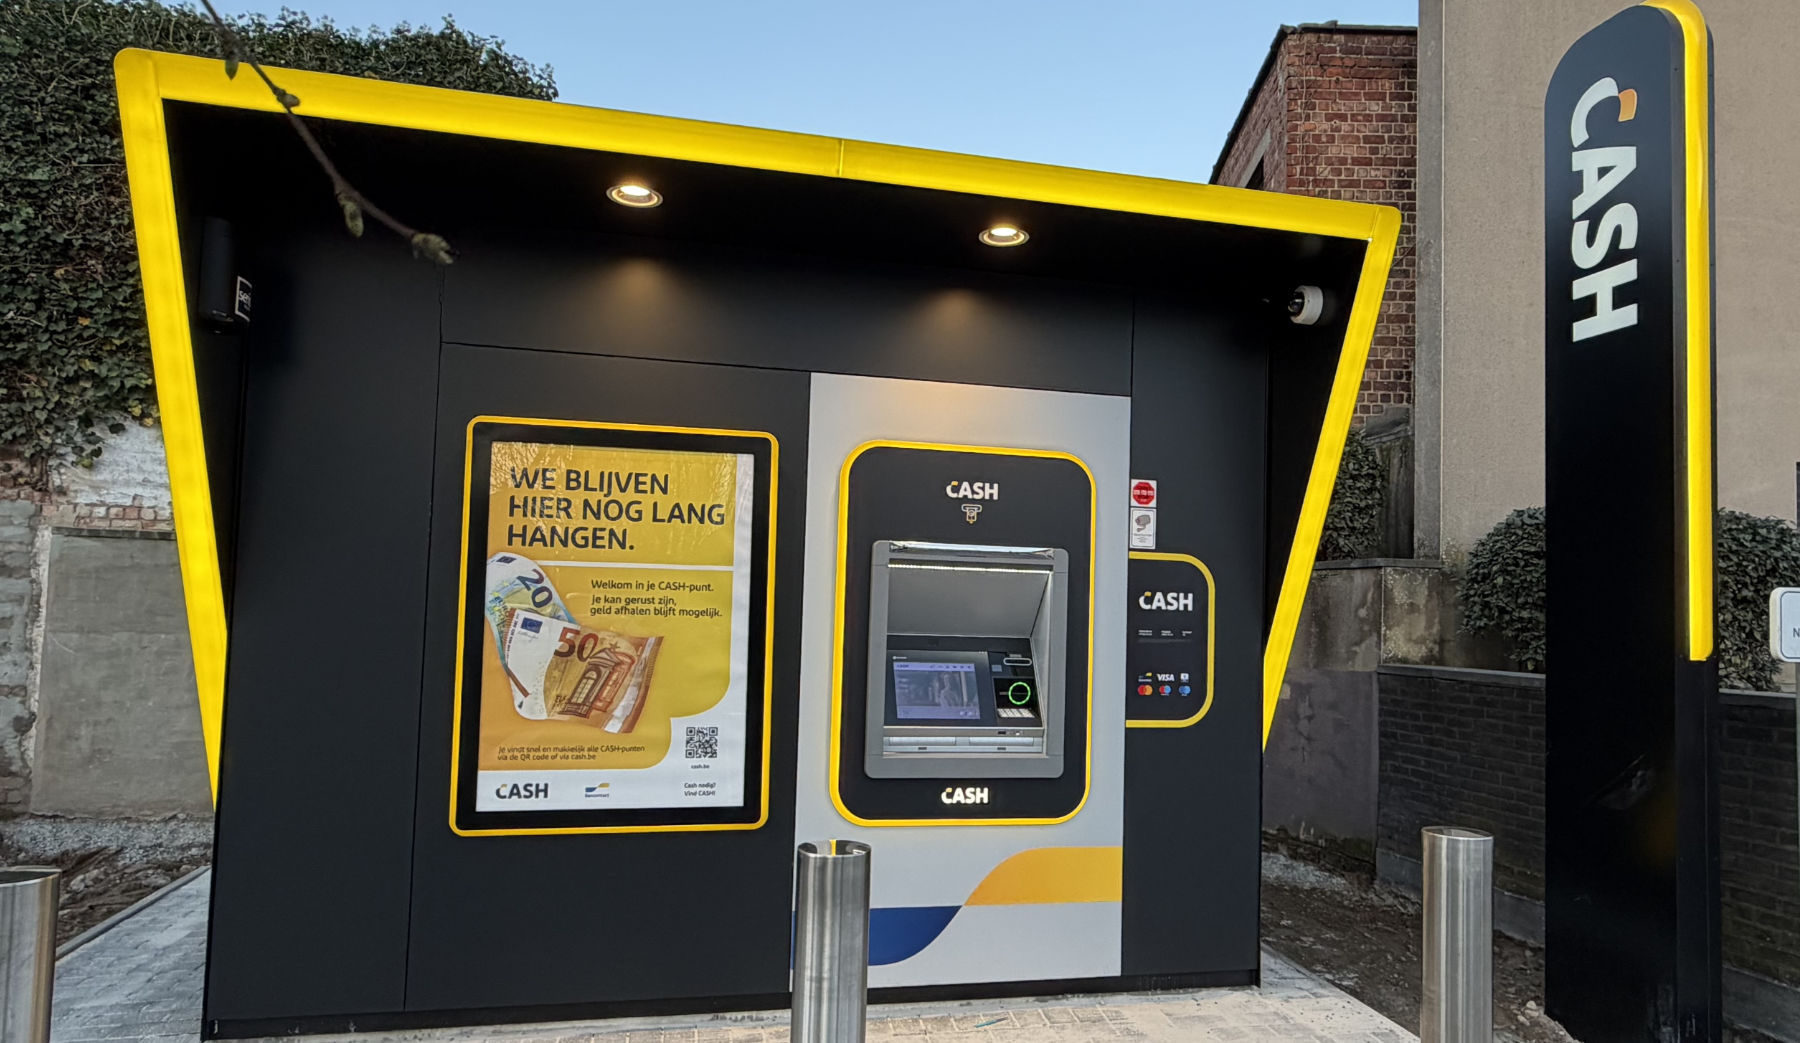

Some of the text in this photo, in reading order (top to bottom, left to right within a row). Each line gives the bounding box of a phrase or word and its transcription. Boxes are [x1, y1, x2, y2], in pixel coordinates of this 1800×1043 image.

[1570, 76, 1639, 342] CASH
[510, 466, 669, 498] WE BLIJVEN
[946, 480, 999, 500] CASH
[508, 495, 725, 526] HIER NOG LANG
[507, 524, 635, 551] HANGEN.
[516, 568, 553, 608] 20
[591, 579, 714, 593] Welkom in je CASH-punt.
[604, 594, 622, 604] kan
[624, 596, 656, 606] gerust
[658, 596, 677, 607] zijn,
[1138, 591, 1193, 611] CASH
[590, 605, 723, 619] geld afhalen blijft mogelijk.
[553, 626, 599, 663] 50
[1156, 673, 1175, 682] VISA
[509, 753, 519, 761] de
[520, 753, 531, 762] QR
[532, 753, 549, 761] code
[550, 752, 558, 761] of
[559, 753, 570, 761] via
[570, 752, 597, 761] cash.be
[526, 745, 541, 753] snel
[495, 782, 549, 799] CASH
[941, 787, 989, 804] CASH
